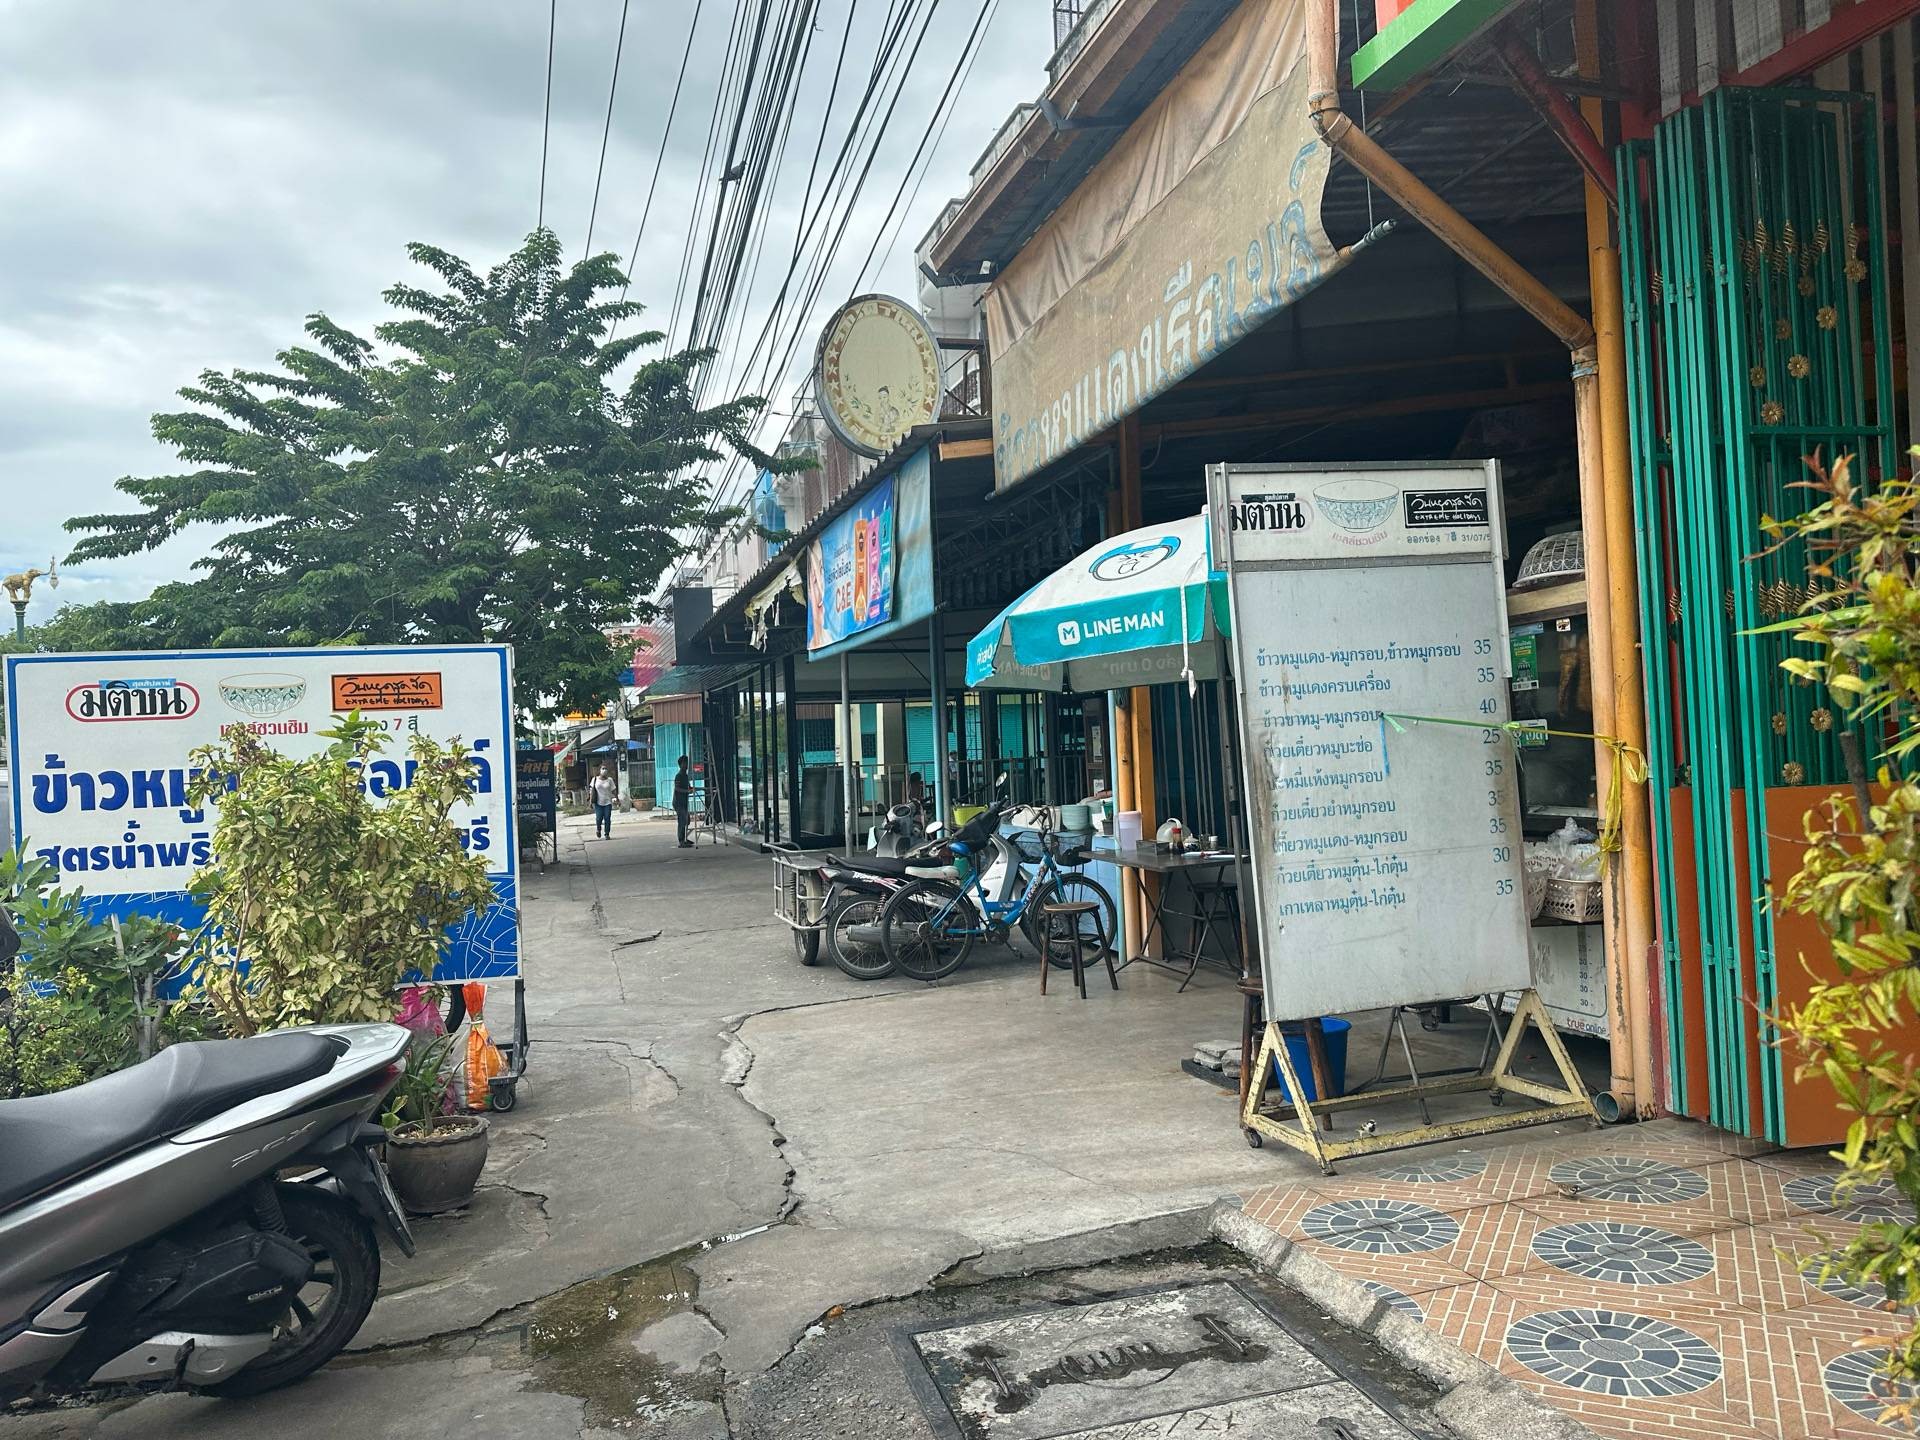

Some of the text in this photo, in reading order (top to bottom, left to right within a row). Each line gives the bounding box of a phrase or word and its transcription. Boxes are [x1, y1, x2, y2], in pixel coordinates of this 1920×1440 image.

[1083, 619, 1122, 638] LINE
[1124, 610, 1165, 633] MAN
[1474, 639, 1491, 655] 35
[1477, 667, 1495, 683] 35
[80, 681, 188, 718] มติชน
[1480, 699, 1497, 714] 40
[393, 718, 403, 731] 7
[1483, 729, 1501, 744] 25
[1486, 760, 1503, 776] 35
[1489, 818, 1507, 834] 35
[1493, 847, 1511, 863] 30
[1495, 880, 1513, 896] 35
